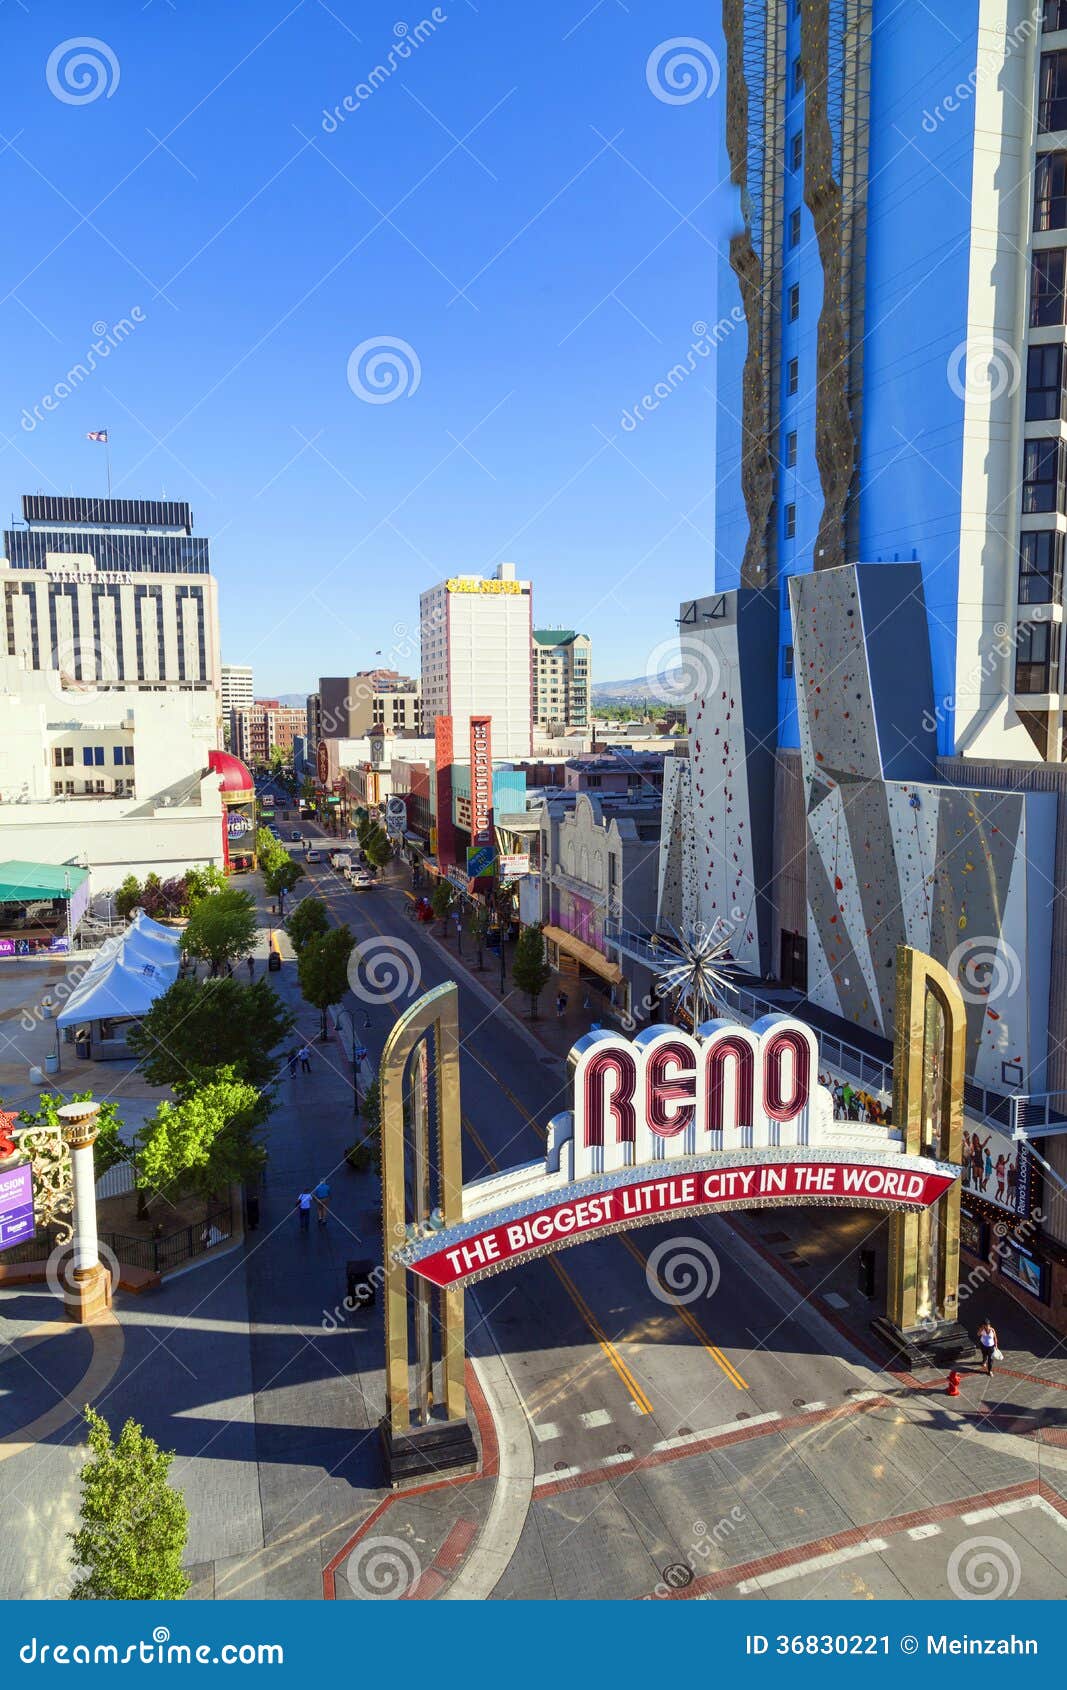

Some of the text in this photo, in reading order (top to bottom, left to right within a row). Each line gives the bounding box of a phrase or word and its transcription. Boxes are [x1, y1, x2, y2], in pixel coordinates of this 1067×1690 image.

[50, 571, 134, 585] VIRGINIAN
[584, 1029, 811, 1148] RENO
[446, 1167, 924, 1274] THE BIGGEST LITTLE CITY IN THE WORLD
